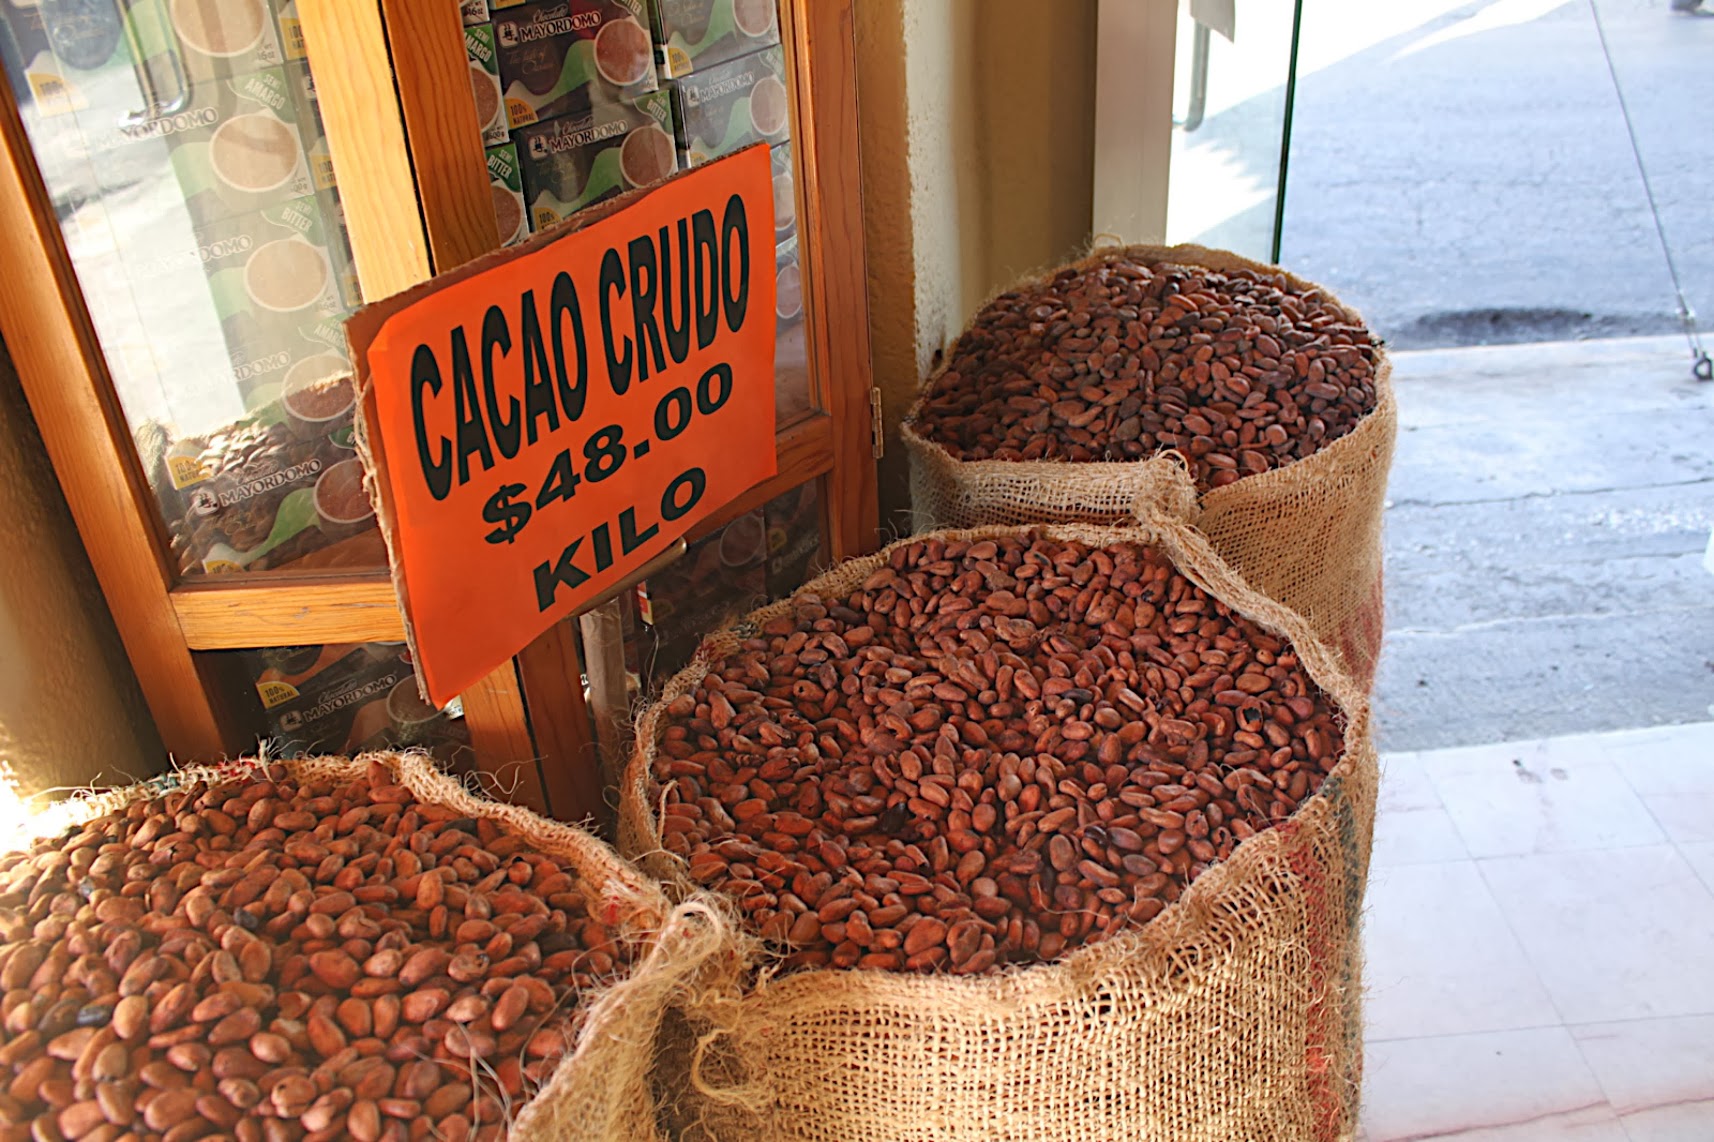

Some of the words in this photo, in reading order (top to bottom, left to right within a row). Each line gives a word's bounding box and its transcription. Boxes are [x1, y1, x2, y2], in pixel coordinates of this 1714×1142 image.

[519, 10, 603, 43] MAYORDOMO
[244, 78, 287, 111] AMARGO
[646, 98, 667, 122] BITTER
[549, 119, 629, 155] MAYORDOMO
[487, 154, 513, 179] BITTER
[281, 207, 313, 233] BITTER
[410, 271, 588, 501] CACAO
[599, 193, 750, 396] CRUDO
[481, 362, 734, 545] $48.00
[218, 458, 323, 498] MAYORDOMO
[532, 466, 707, 613] KILO
[265, 686, 285, 700] 100%
[269, 689, 295, 705] NATURAL
[303, 674, 397, 723] MAYORDOMO
